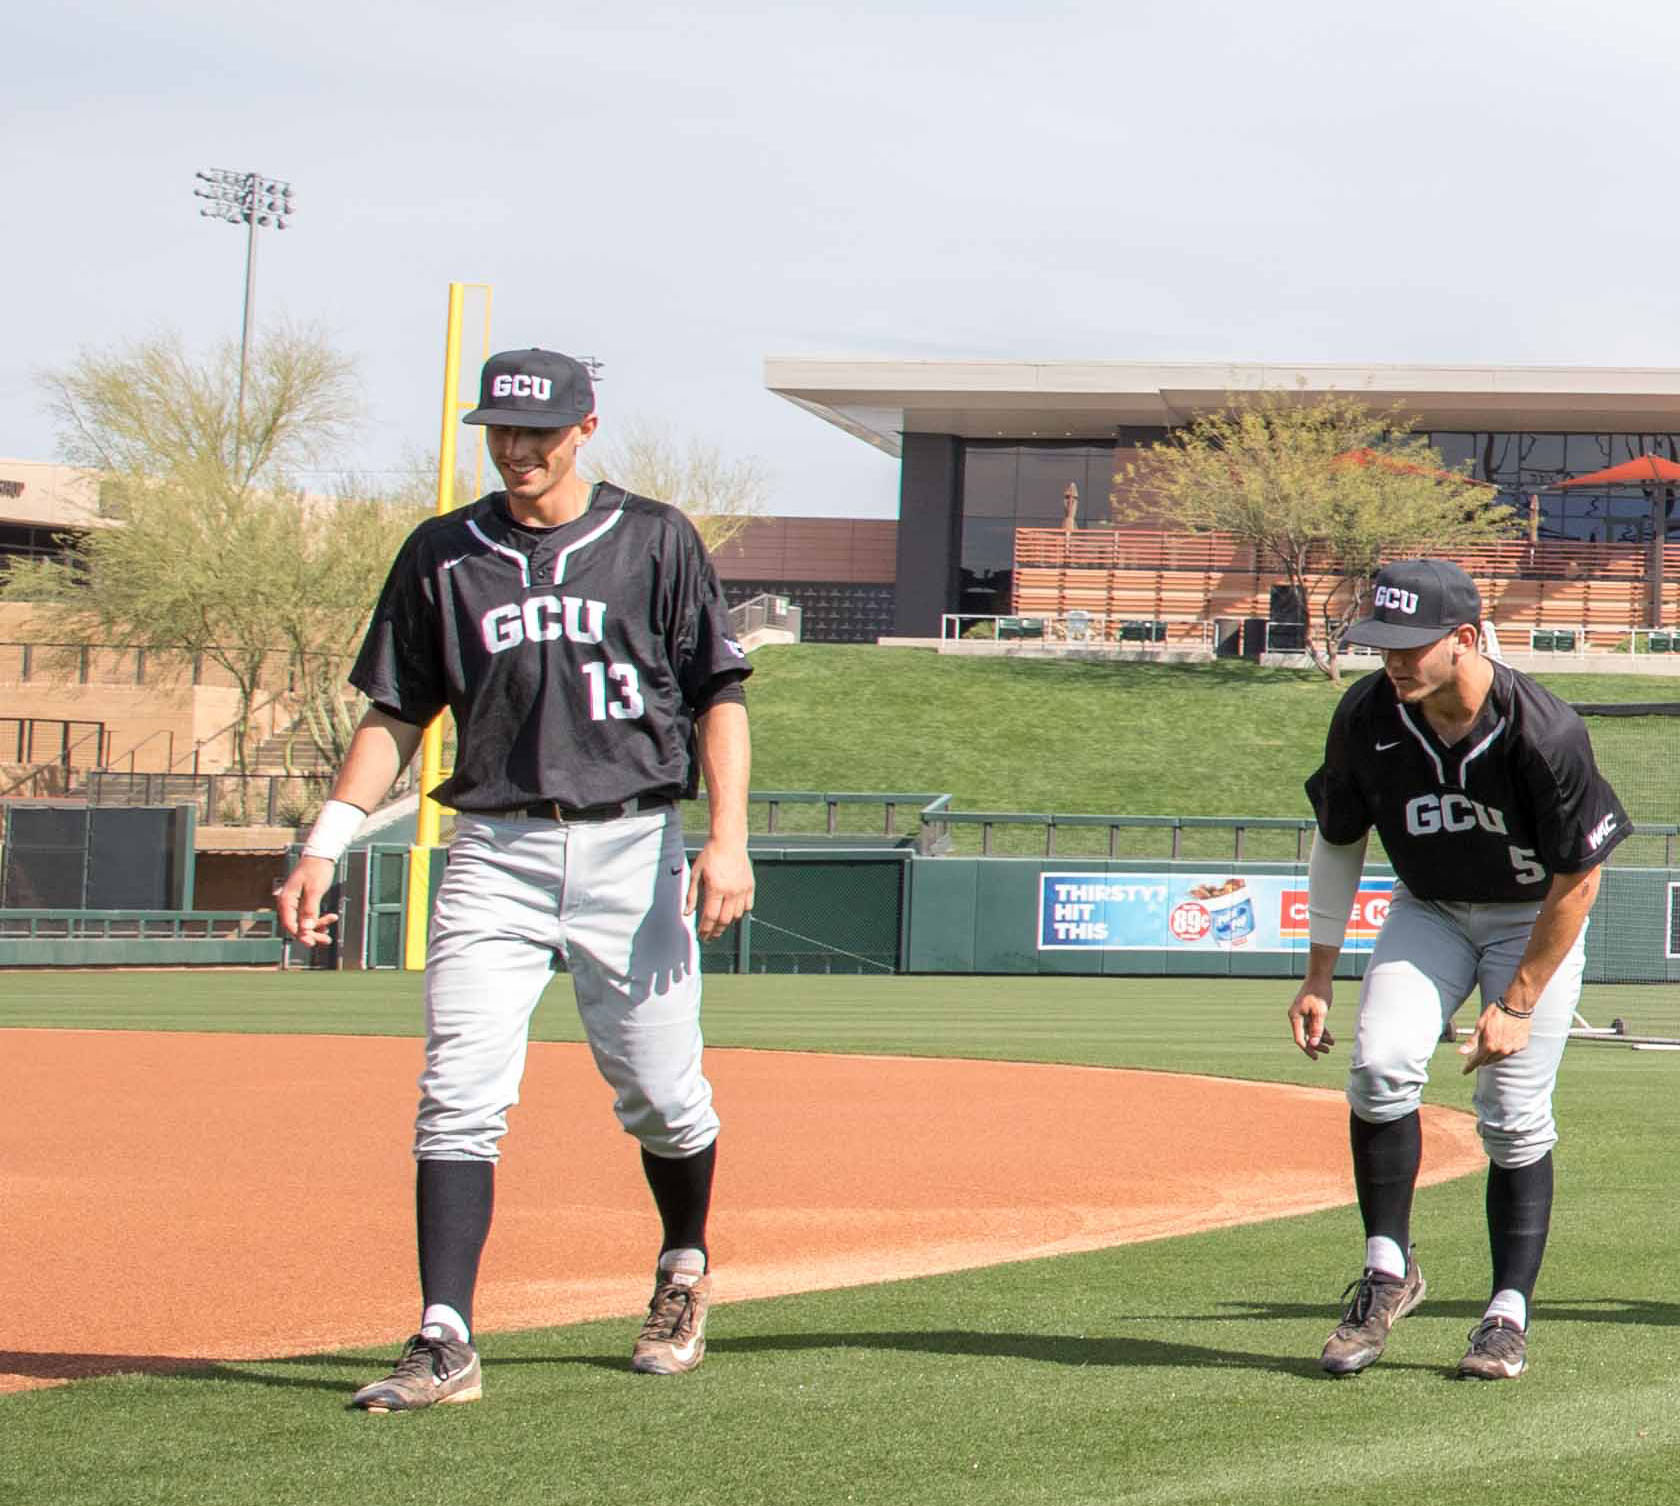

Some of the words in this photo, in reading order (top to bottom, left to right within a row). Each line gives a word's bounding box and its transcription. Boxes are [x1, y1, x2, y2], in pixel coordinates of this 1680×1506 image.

[492, 375, 552, 400] GCU
[1375, 586, 1419, 615] GCU
[481, 595, 607, 654] GCU
[581, 661, 644, 720] 13
[1405, 794, 1509, 836] GCU
[1587, 813, 1617, 849] WAC
[1509, 846, 1546, 885] 5
[1055, 884, 1168, 902] THIRSTY?
[1055, 903, 1095, 921] HIT
[1054, 922, 1109, 940] THIS
